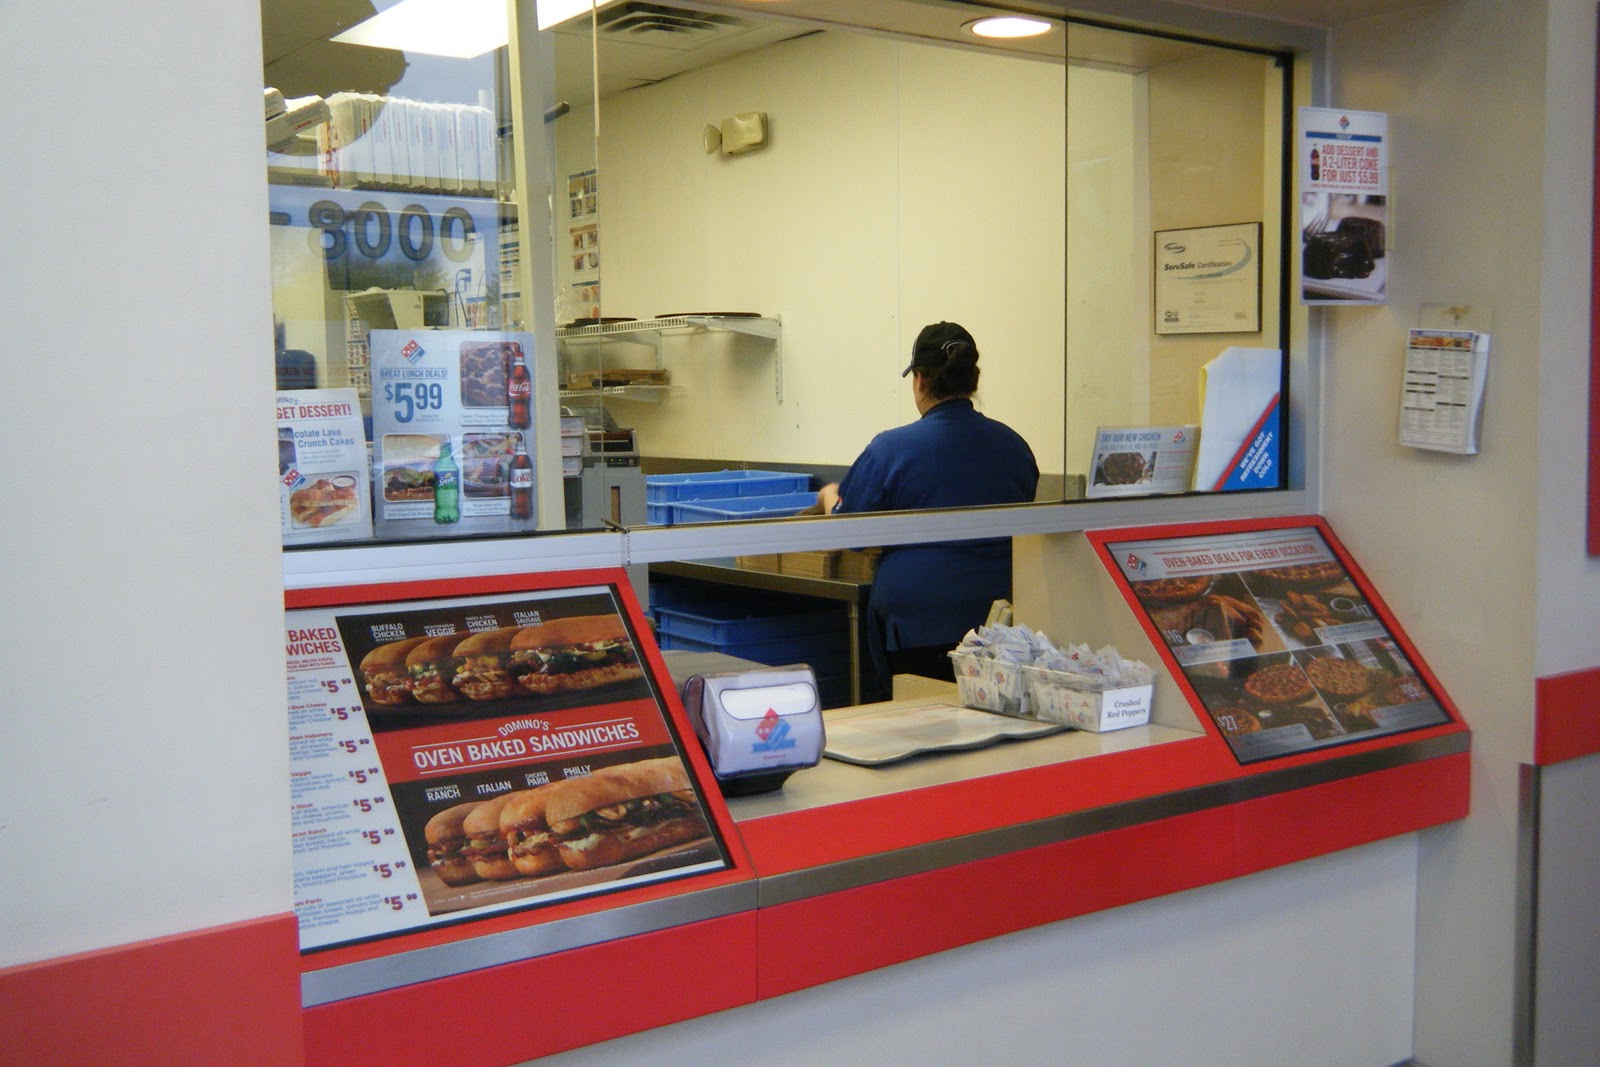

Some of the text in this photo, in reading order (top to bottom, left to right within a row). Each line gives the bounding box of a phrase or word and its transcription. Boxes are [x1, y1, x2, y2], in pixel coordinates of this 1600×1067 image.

[1322, 144, 1335, 155] ADD
[1336, 145, 1364, 156] DESSERT
[1329, 156, 1358, 170] 2-LITER
[1359, 158, 1379, 170] COKE
[1322, 169, 1338, 182] FOR
[1340, 170, 1356, 183] JUST
[1164, 260, 1232, 270] ServSafe Certification
[380, 370, 448, 378] GREAT LUNCH DEALS!
[299, 404, 352, 418] DESSERT!
[279, 428, 342, 440] Chocolate Lava
[1113, 433, 1124, 442] OUR
[1126, 432, 1138, 442] NEW
[1138, 432, 1162, 441] CHICKEN
[298, 437, 354, 448] Crunch Cakes
[1240, 431, 1265, 469] WE'VE GOT
[1240, 431, 1274, 482] REFRESHMENT
[1254, 452, 1269, 474] DOWN
[1258, 459, 1272, 478] COLD
[1162, 544, 1318, 568] OVEN-BAKED DEALS FOR EVERY OCCASION
[371, 623, 404, 632] BUFFALO
[467, 619, 498, 628] CHICKEN
[288, 628, 336, 642] BAKED
[373, 630, 406, 638] CHICKEN
[426, 627, 456, 636] VEGGIE
[286, 641, 342, 656] WICHES
[1114, 698, 1141, 708] Crushed
[1107, 707, 1146, 718] Red Peppers
[498, 720, 550, 737] DOMINO'S
[414, 722, 640, 768] OVEN BAKED SANDWICHES
[563, 764, 590, 776] PHILLY
[476, 780, 512, 794] ITALIAN
[526, 776, 550, 786] PARM
[426, 788, 461, 802] RANCH
